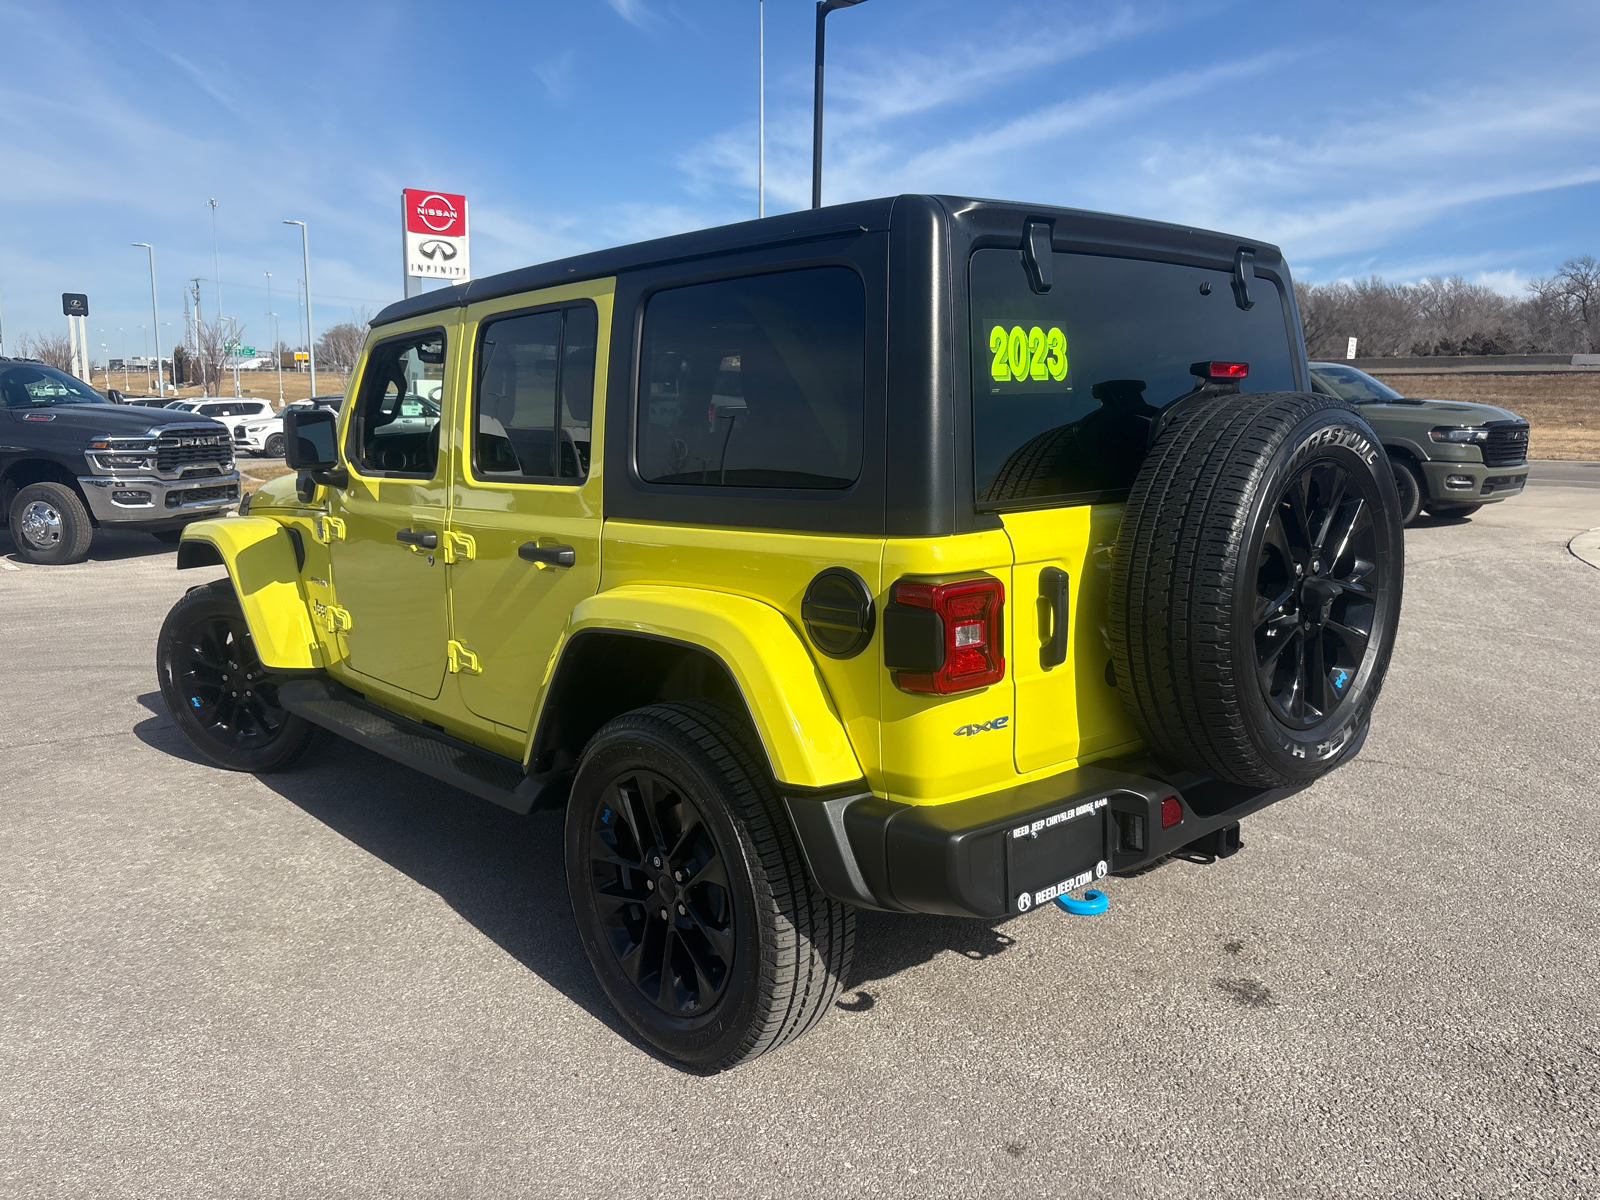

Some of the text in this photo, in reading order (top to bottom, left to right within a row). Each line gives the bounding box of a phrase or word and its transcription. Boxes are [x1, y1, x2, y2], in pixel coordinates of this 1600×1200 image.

[417, 207, 457, 219] NISSAN
[411, 263, 466, 276] INFINITI
[989, 325, 1068, 382] 2023
[181, 435, 220, 447] RAM
[953, 715, 1009, 737] 4xe
[1013, 797, 1108, 838] REED JEEP CHRYSLER DODGE RAM
[1035, 870, 1093, 905] REEDJEEP.COM
